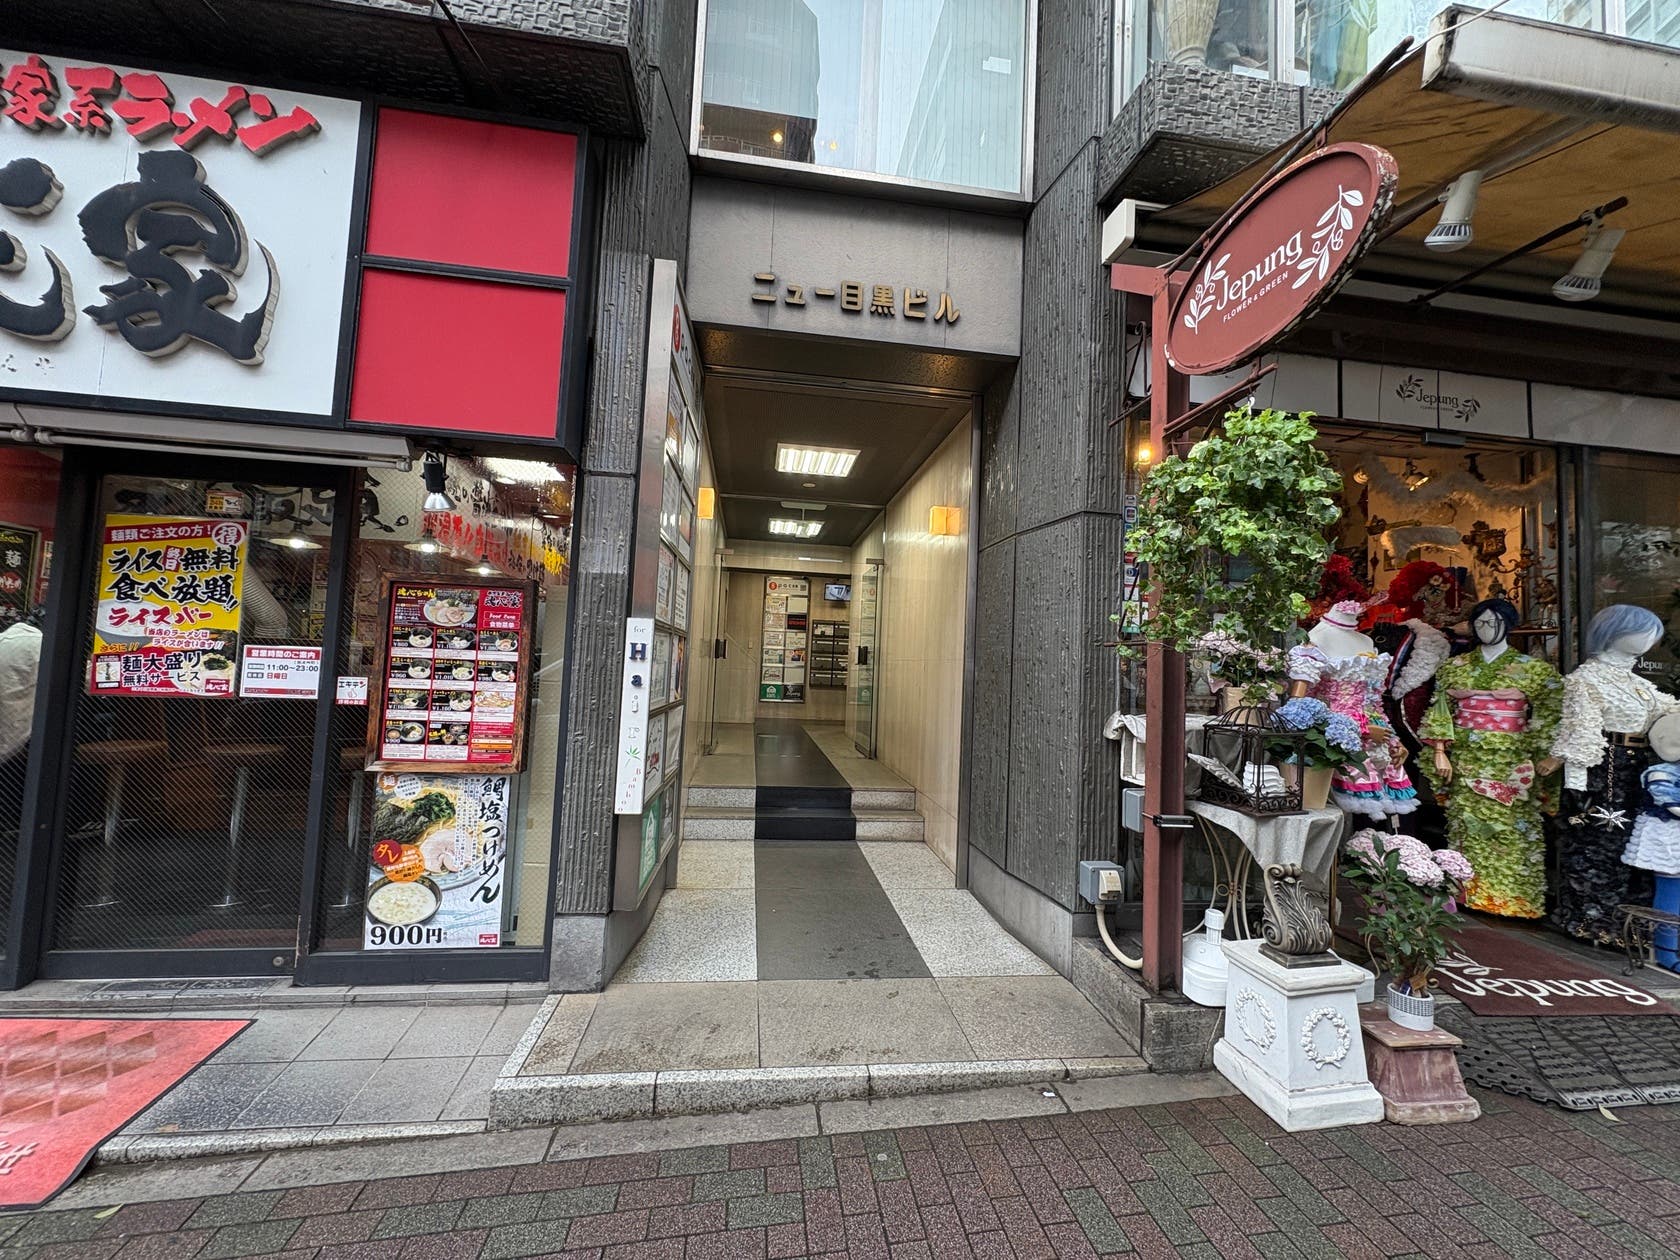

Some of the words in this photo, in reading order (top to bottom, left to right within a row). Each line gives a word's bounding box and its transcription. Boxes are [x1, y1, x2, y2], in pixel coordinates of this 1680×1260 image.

[1216, 230, 1303, 311] Jepung
[752, 272, 960, 324] ニュー目黒ビル
[1223, 296, 1253, 323] FLOWER
[1259, 271, 1289, 297] GREEN
[1416, 388, 1459, 408] Jepung
[109, 606, 212, 626] ライスバー
[633, 625, 646, 633] for
[122, 651, 203, 674] 麺大盛り
[251, 649, 316, 660] 営業時間のご案内
[123, 671, 201, 687] 無料サービス
[628, 642, 648, 739] Hair
[470, 776, 507, 904] 鯛塩つけめん
[376, 844, 400, 863] タレ
[370, 925, 442, 946] 900円
